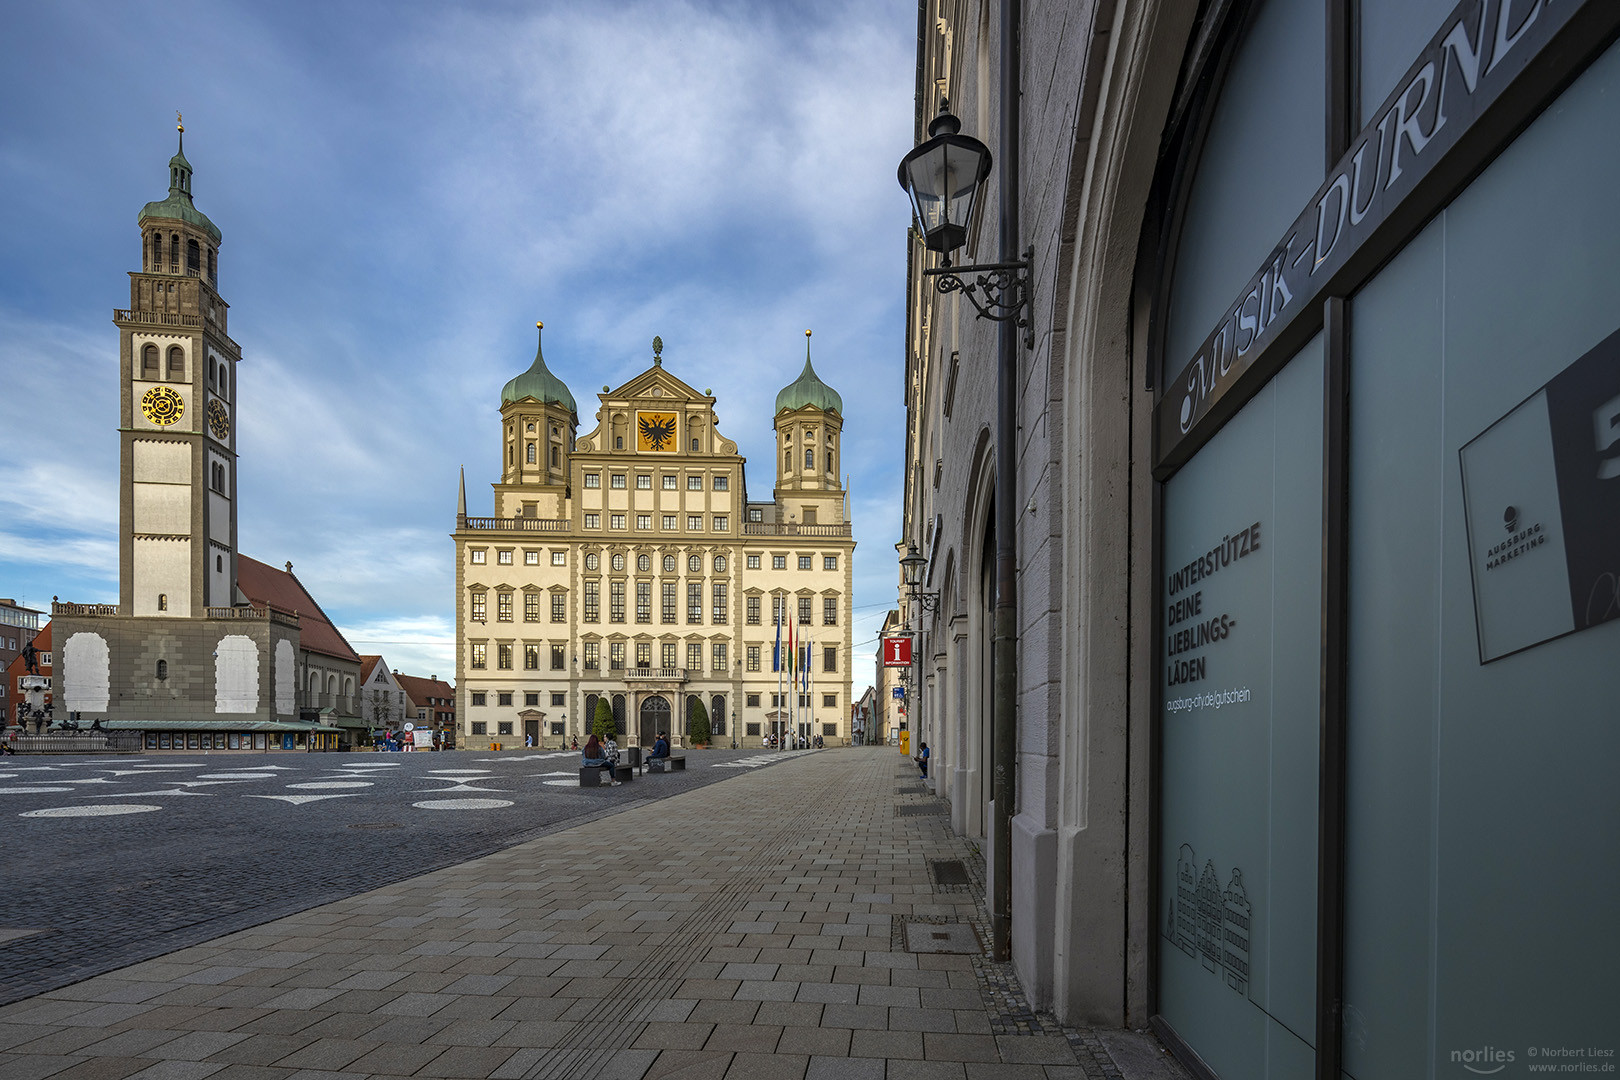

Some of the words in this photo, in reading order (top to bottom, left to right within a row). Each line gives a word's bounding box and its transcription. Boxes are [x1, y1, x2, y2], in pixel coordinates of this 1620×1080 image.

[1486, 535, 1545, 571] MARKETING
[1487, 523, 1541, 558] AUGSBURG
[1168, 521, 1260, 597] UNTERSTÜTZE
[1168, 590, 1202, 627] DEINE
[1168, 613, 1236, 657] LIEBLINGS-
[1167, 656, 1206, 687] LÄDEN
